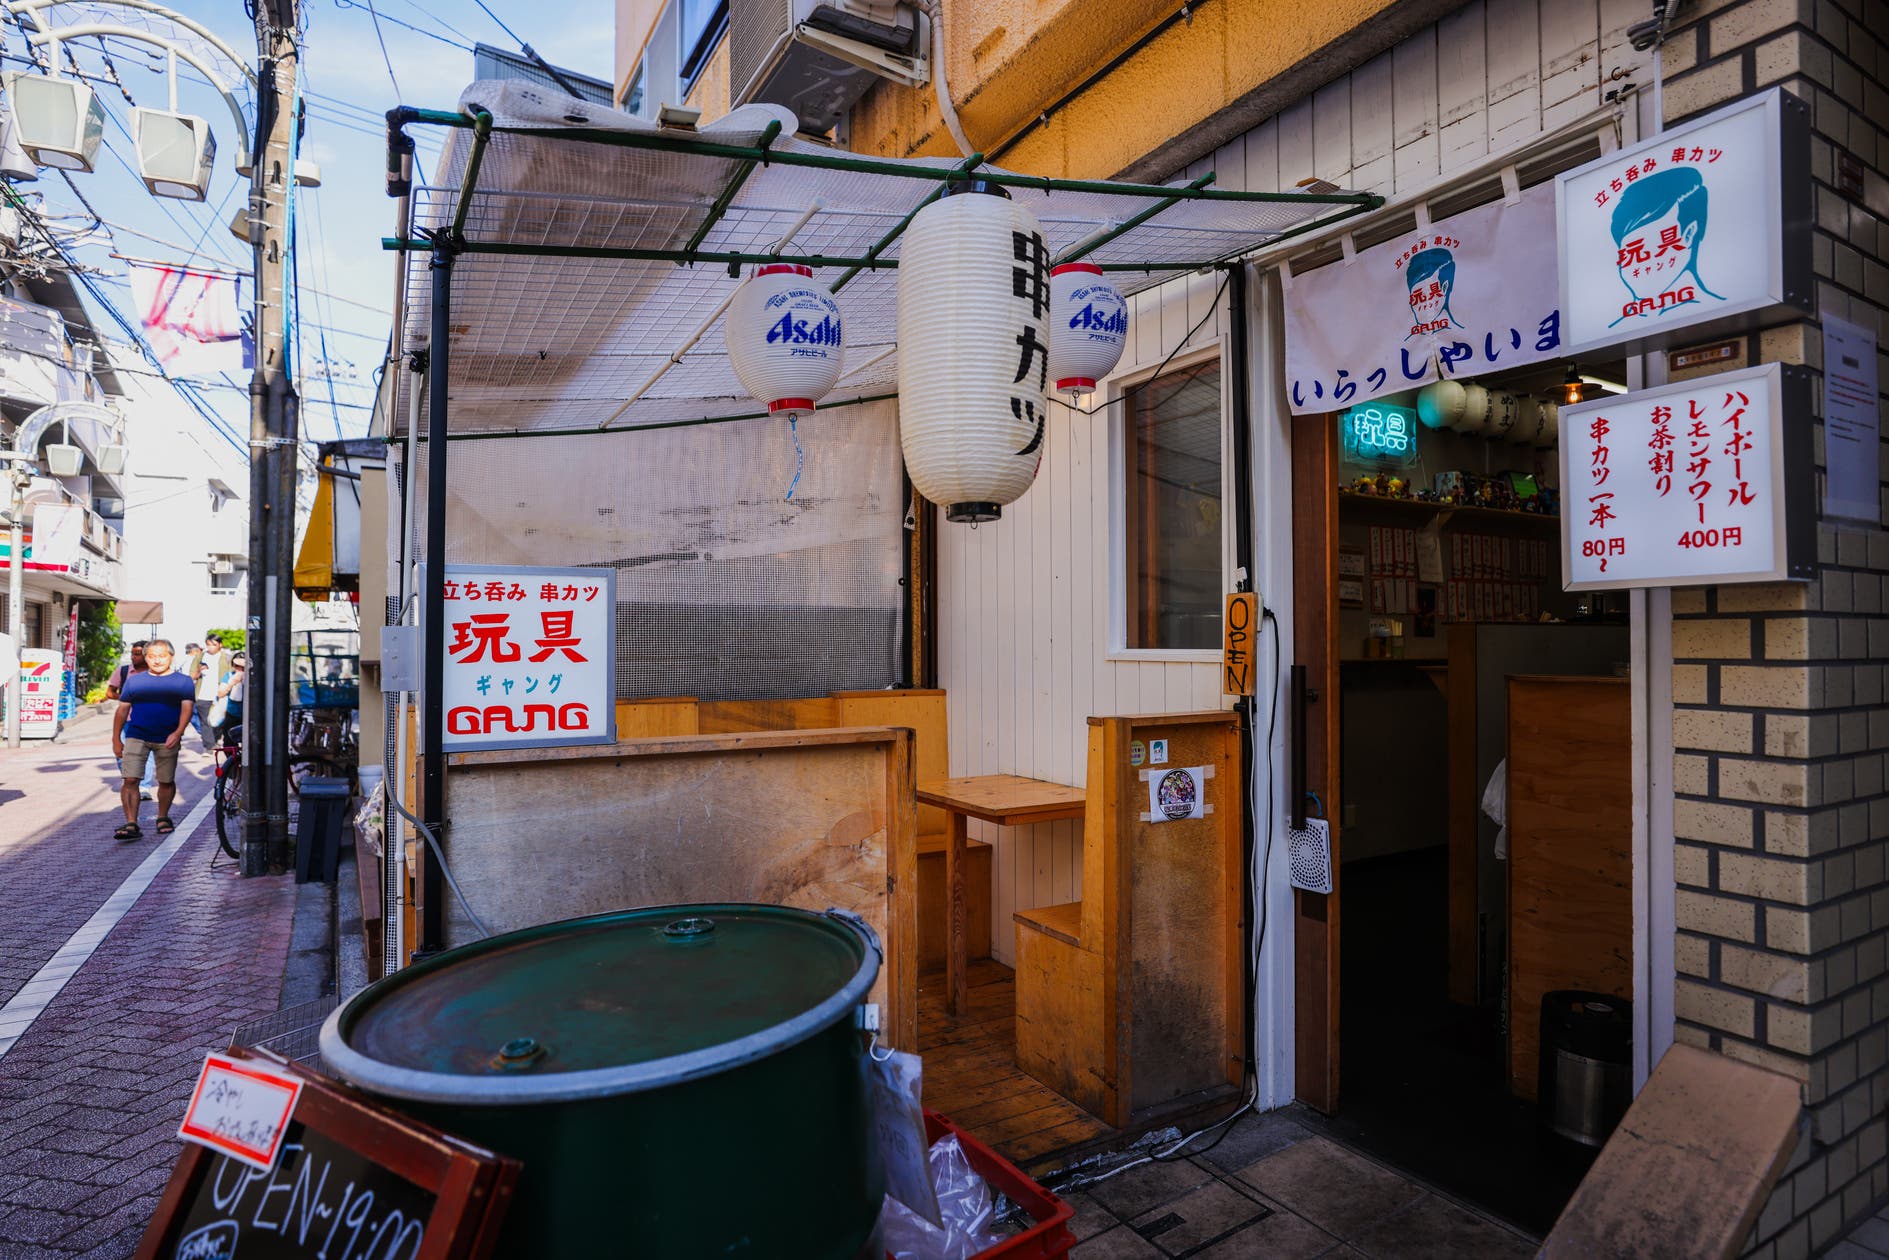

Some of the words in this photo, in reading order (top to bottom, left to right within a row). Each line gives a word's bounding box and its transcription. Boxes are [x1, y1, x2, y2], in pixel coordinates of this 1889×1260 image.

[1594, 158, 1657, 208] 立ち呑み
[1671, 146, 1722, 164] 串カツ
[1395, 240, 1427, 269] 立ち呑み
[1434, 236, 1460, 249] 串カツ
[1616, 224, 1686, 269] 玩具
[1632, 256, 1677, 278] ギャング
[1409, 281, 1444, 306] 玩具
[1622, 286, 1695, 318] GANG
[766, 310, 841, 348] Asahi
[1069, 302, 1128, 336] Asahi
[1411, 318, 1449, 335] GANG
[790, 348, 827, 358] アサヒビール
[1010, 230, 1050, 455] 串カツ
[1354, 409, 1408, 451] 玩具
[1648, 406, 1676, 498] お茶割り
[1686, 400, 1712, 524] レモンサワー
[1721, 391, 1757, 507] ハイボール
[1678, 527, 1742, 549] 400円
[443, 580, 527, 602] 立ち呑み
[540, 582, 600, 602] 串カツ
[448, 610, 589, 664] 玩具
[1227, 597, 1248, 694] OPEN
[477, 673, 563, 696] ギャング
[447, 702, 590, 735] GANG
